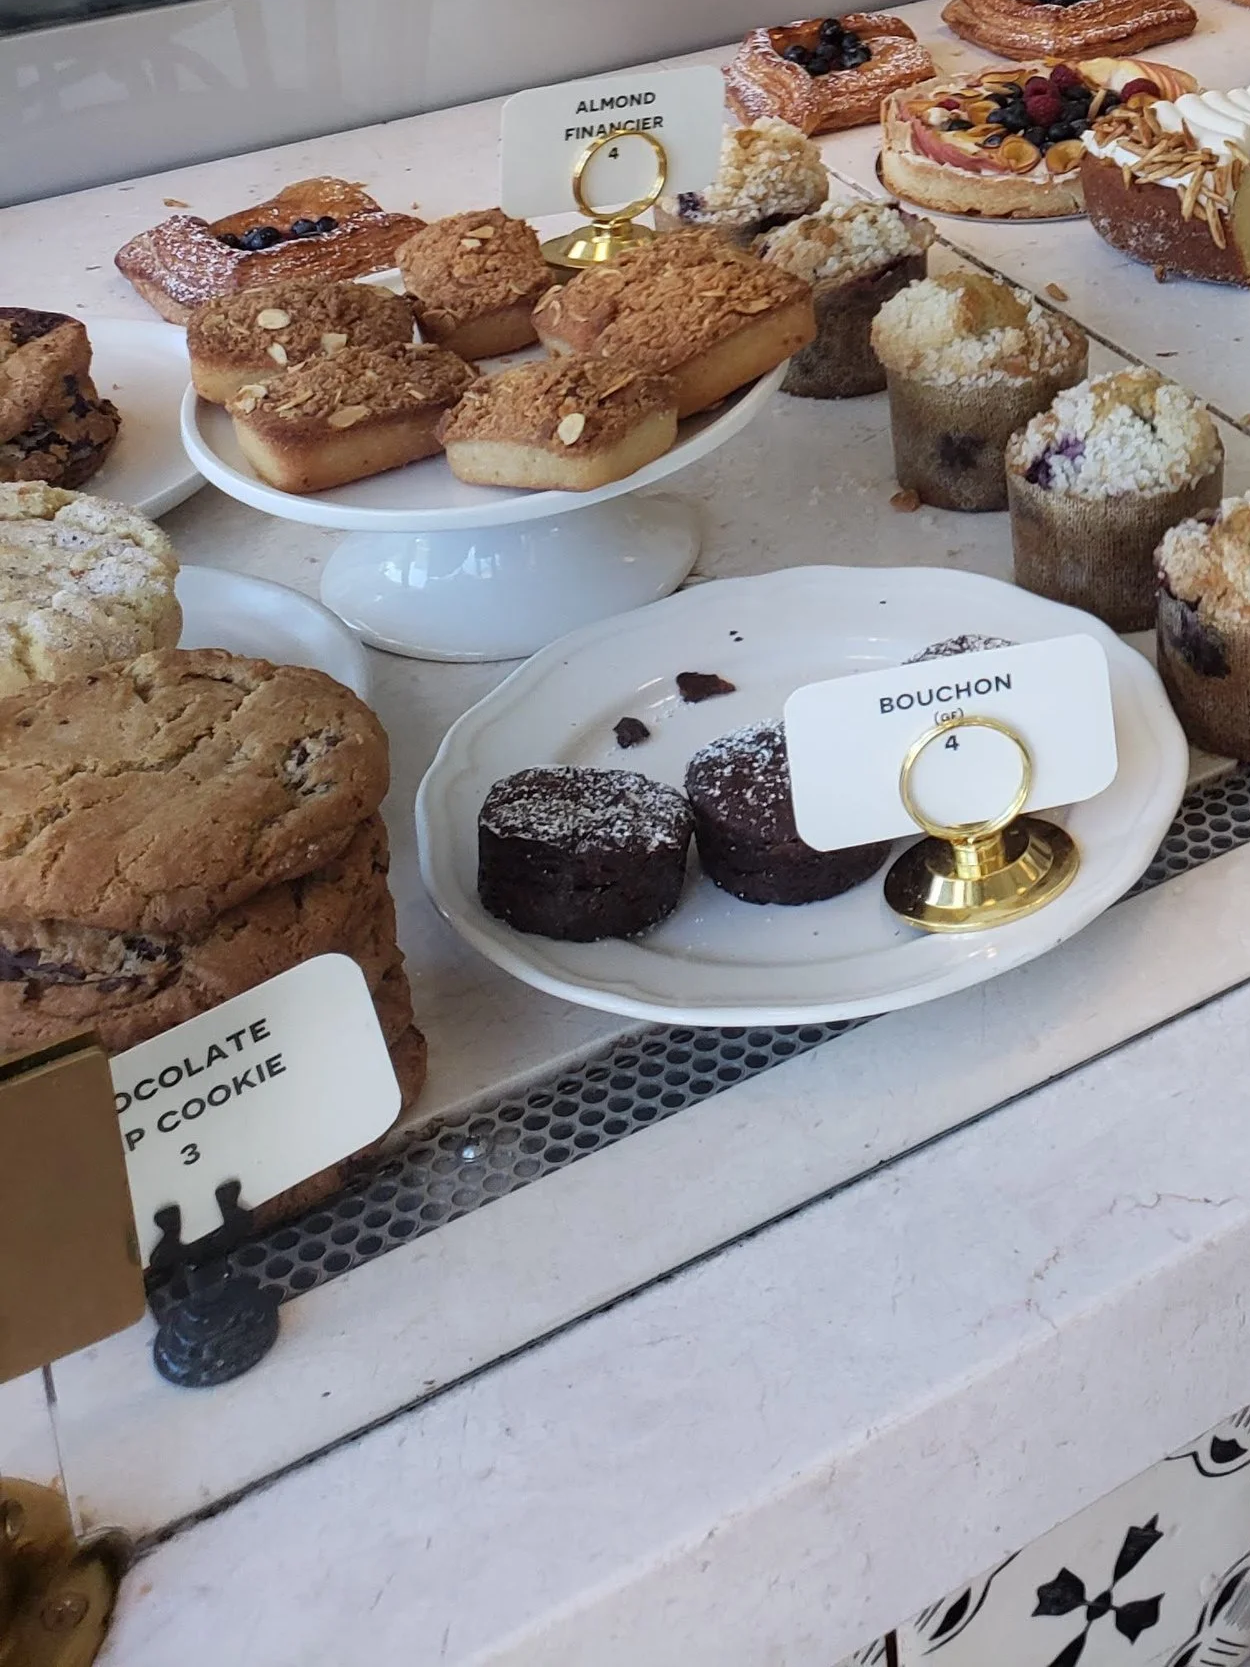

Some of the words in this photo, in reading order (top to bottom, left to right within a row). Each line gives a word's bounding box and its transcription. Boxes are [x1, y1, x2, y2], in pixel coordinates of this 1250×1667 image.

[575, 91, 657, 115] ALMOND
[564, 115, 664, 141] FINANCIER
[608, 146, 620, 160] 4
[879, 672, 1013, 715] BOUCHON
[945, 734, 960, 751] 4
[114, 1017, 271, 1114] OCOLATE
[157, 1052, 287, 1133] COOKIE
[180, 1143, 201, 1166] 3
